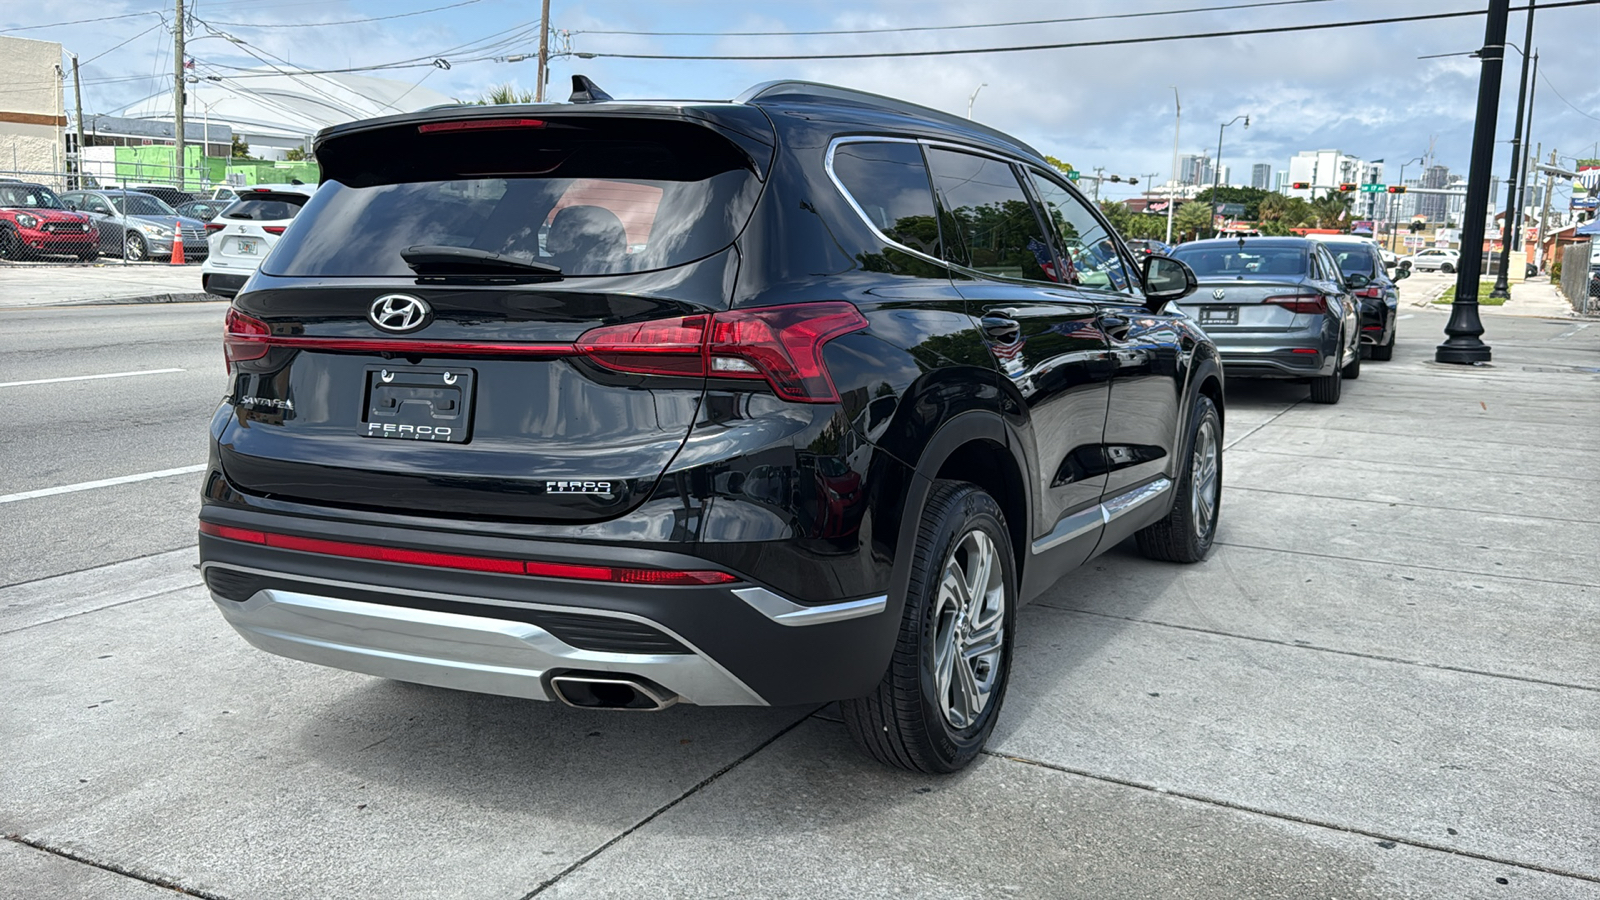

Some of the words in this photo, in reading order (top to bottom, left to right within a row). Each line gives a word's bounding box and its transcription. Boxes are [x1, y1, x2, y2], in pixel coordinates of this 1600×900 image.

[241, 395, 271, 406] SANTA
[368, 422, 452, 434] FERCO
[368, 431, 450, 441] MOTORS
